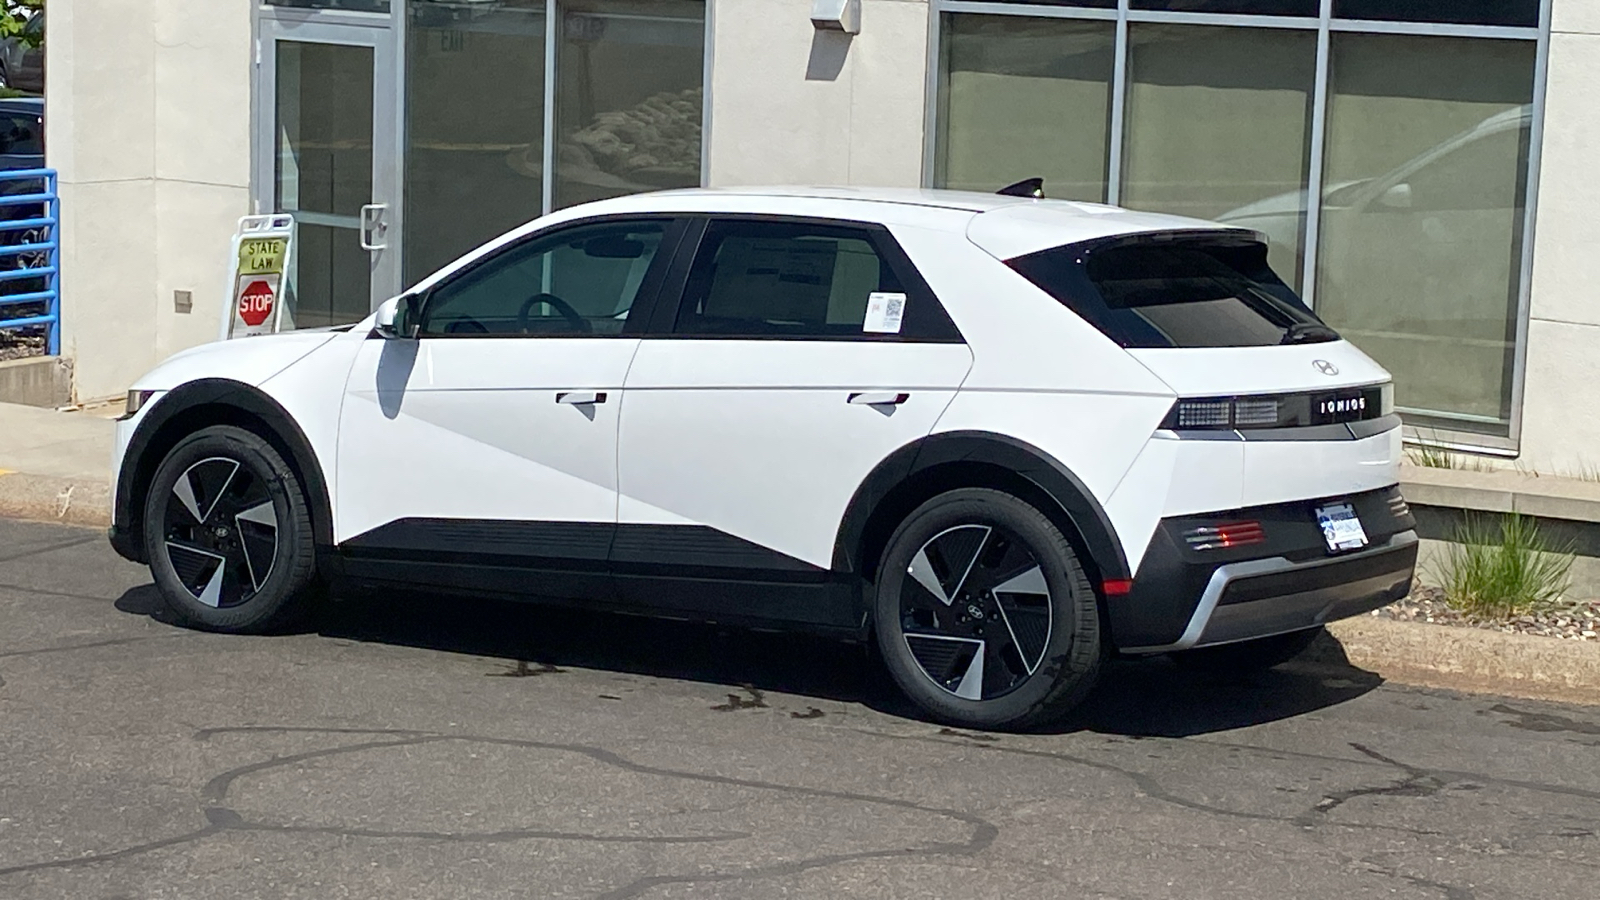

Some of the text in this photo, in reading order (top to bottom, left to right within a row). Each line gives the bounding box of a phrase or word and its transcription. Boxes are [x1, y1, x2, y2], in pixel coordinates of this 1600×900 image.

[248, 241, 280, 255] STATE
[251, 257, 273, 270] LAW
[239, 294, 273, 313] STOP
